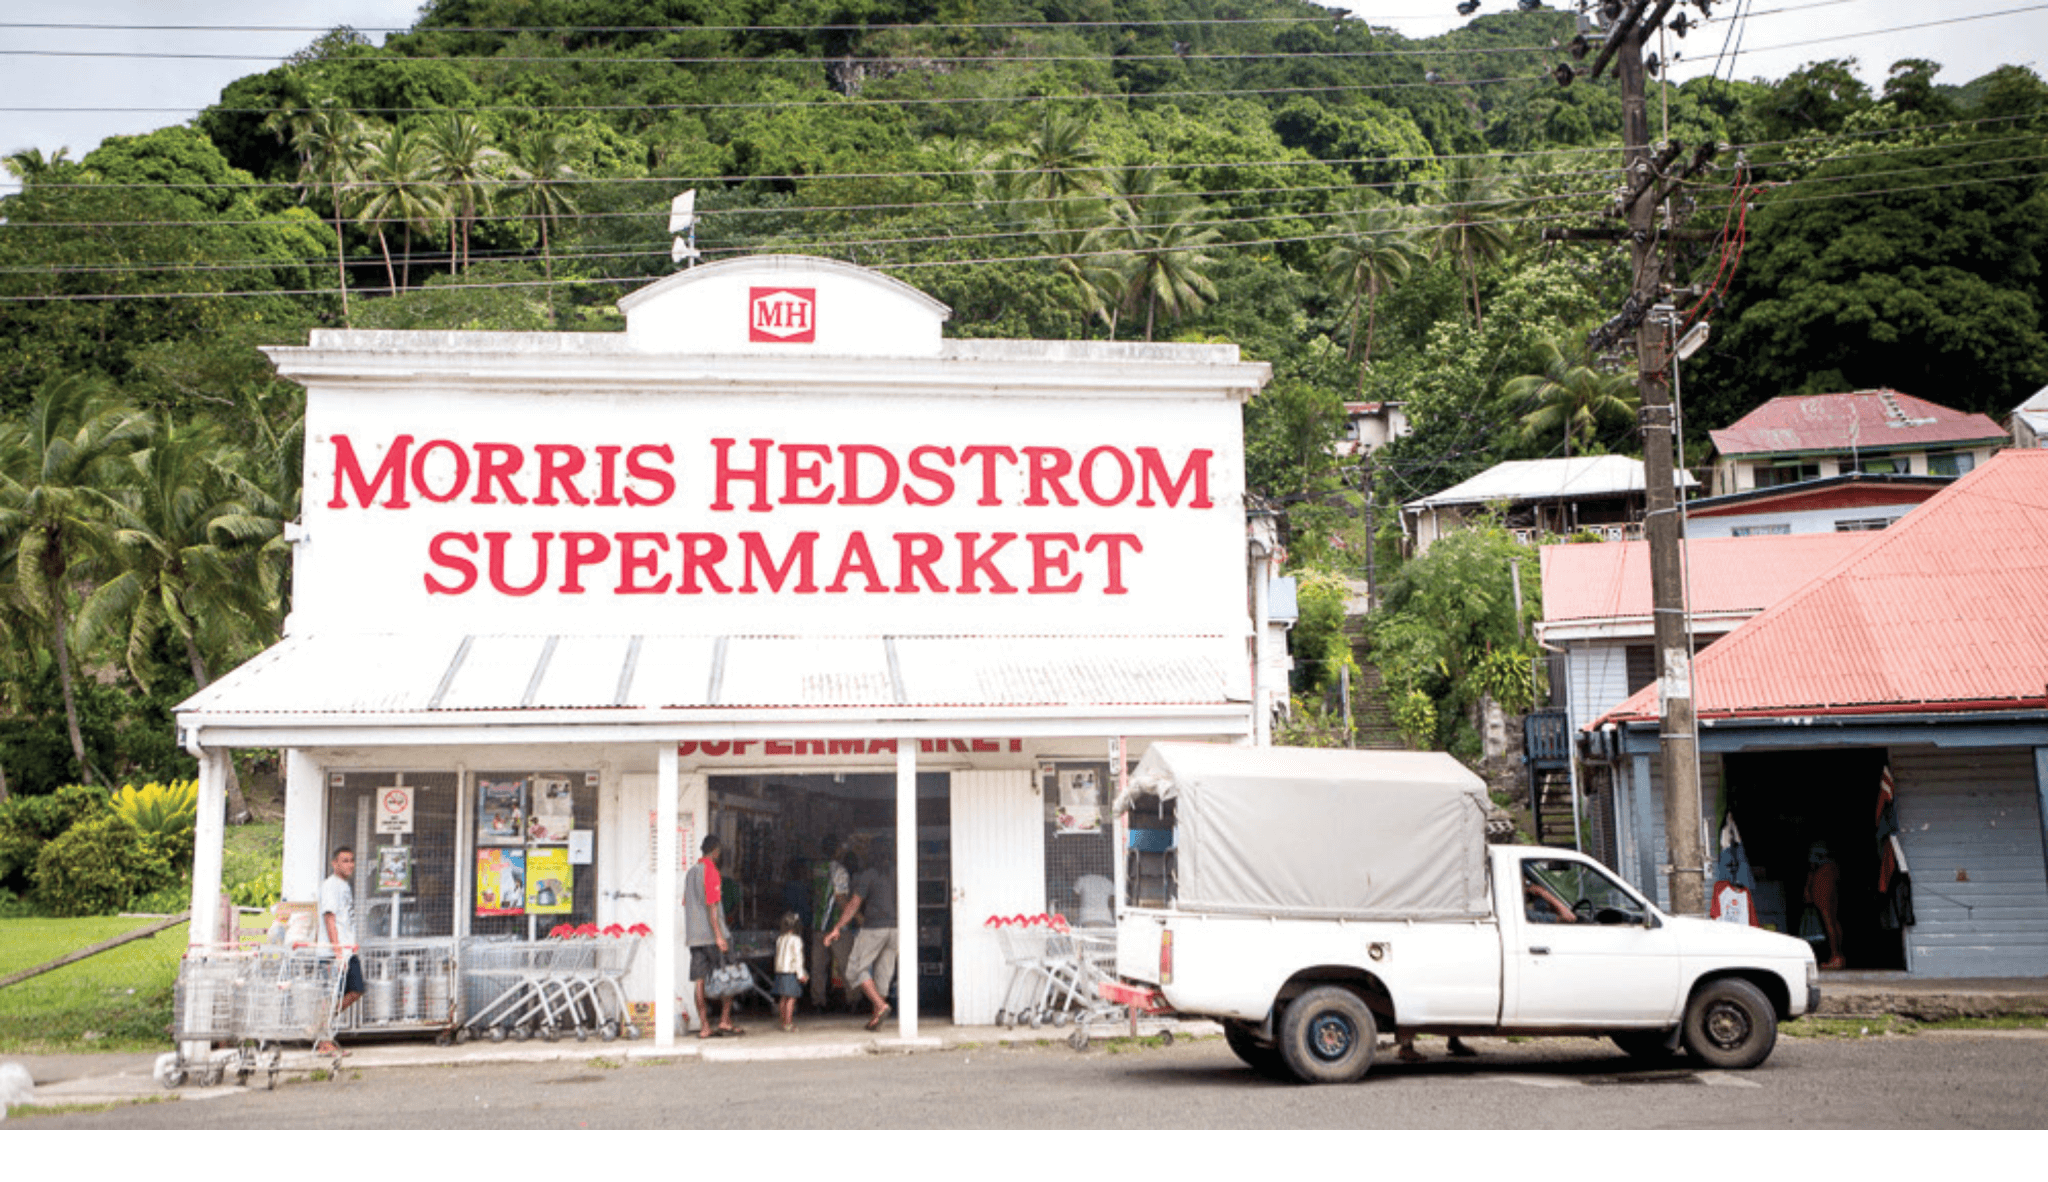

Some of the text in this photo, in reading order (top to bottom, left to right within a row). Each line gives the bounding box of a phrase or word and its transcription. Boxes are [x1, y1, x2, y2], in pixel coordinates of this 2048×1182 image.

[757, 301, 808, 328] MH
[327, 434, 1214, 512] MORRIS HEDSTROM
[423, 530, 1144, 597] SUPERMARKET
